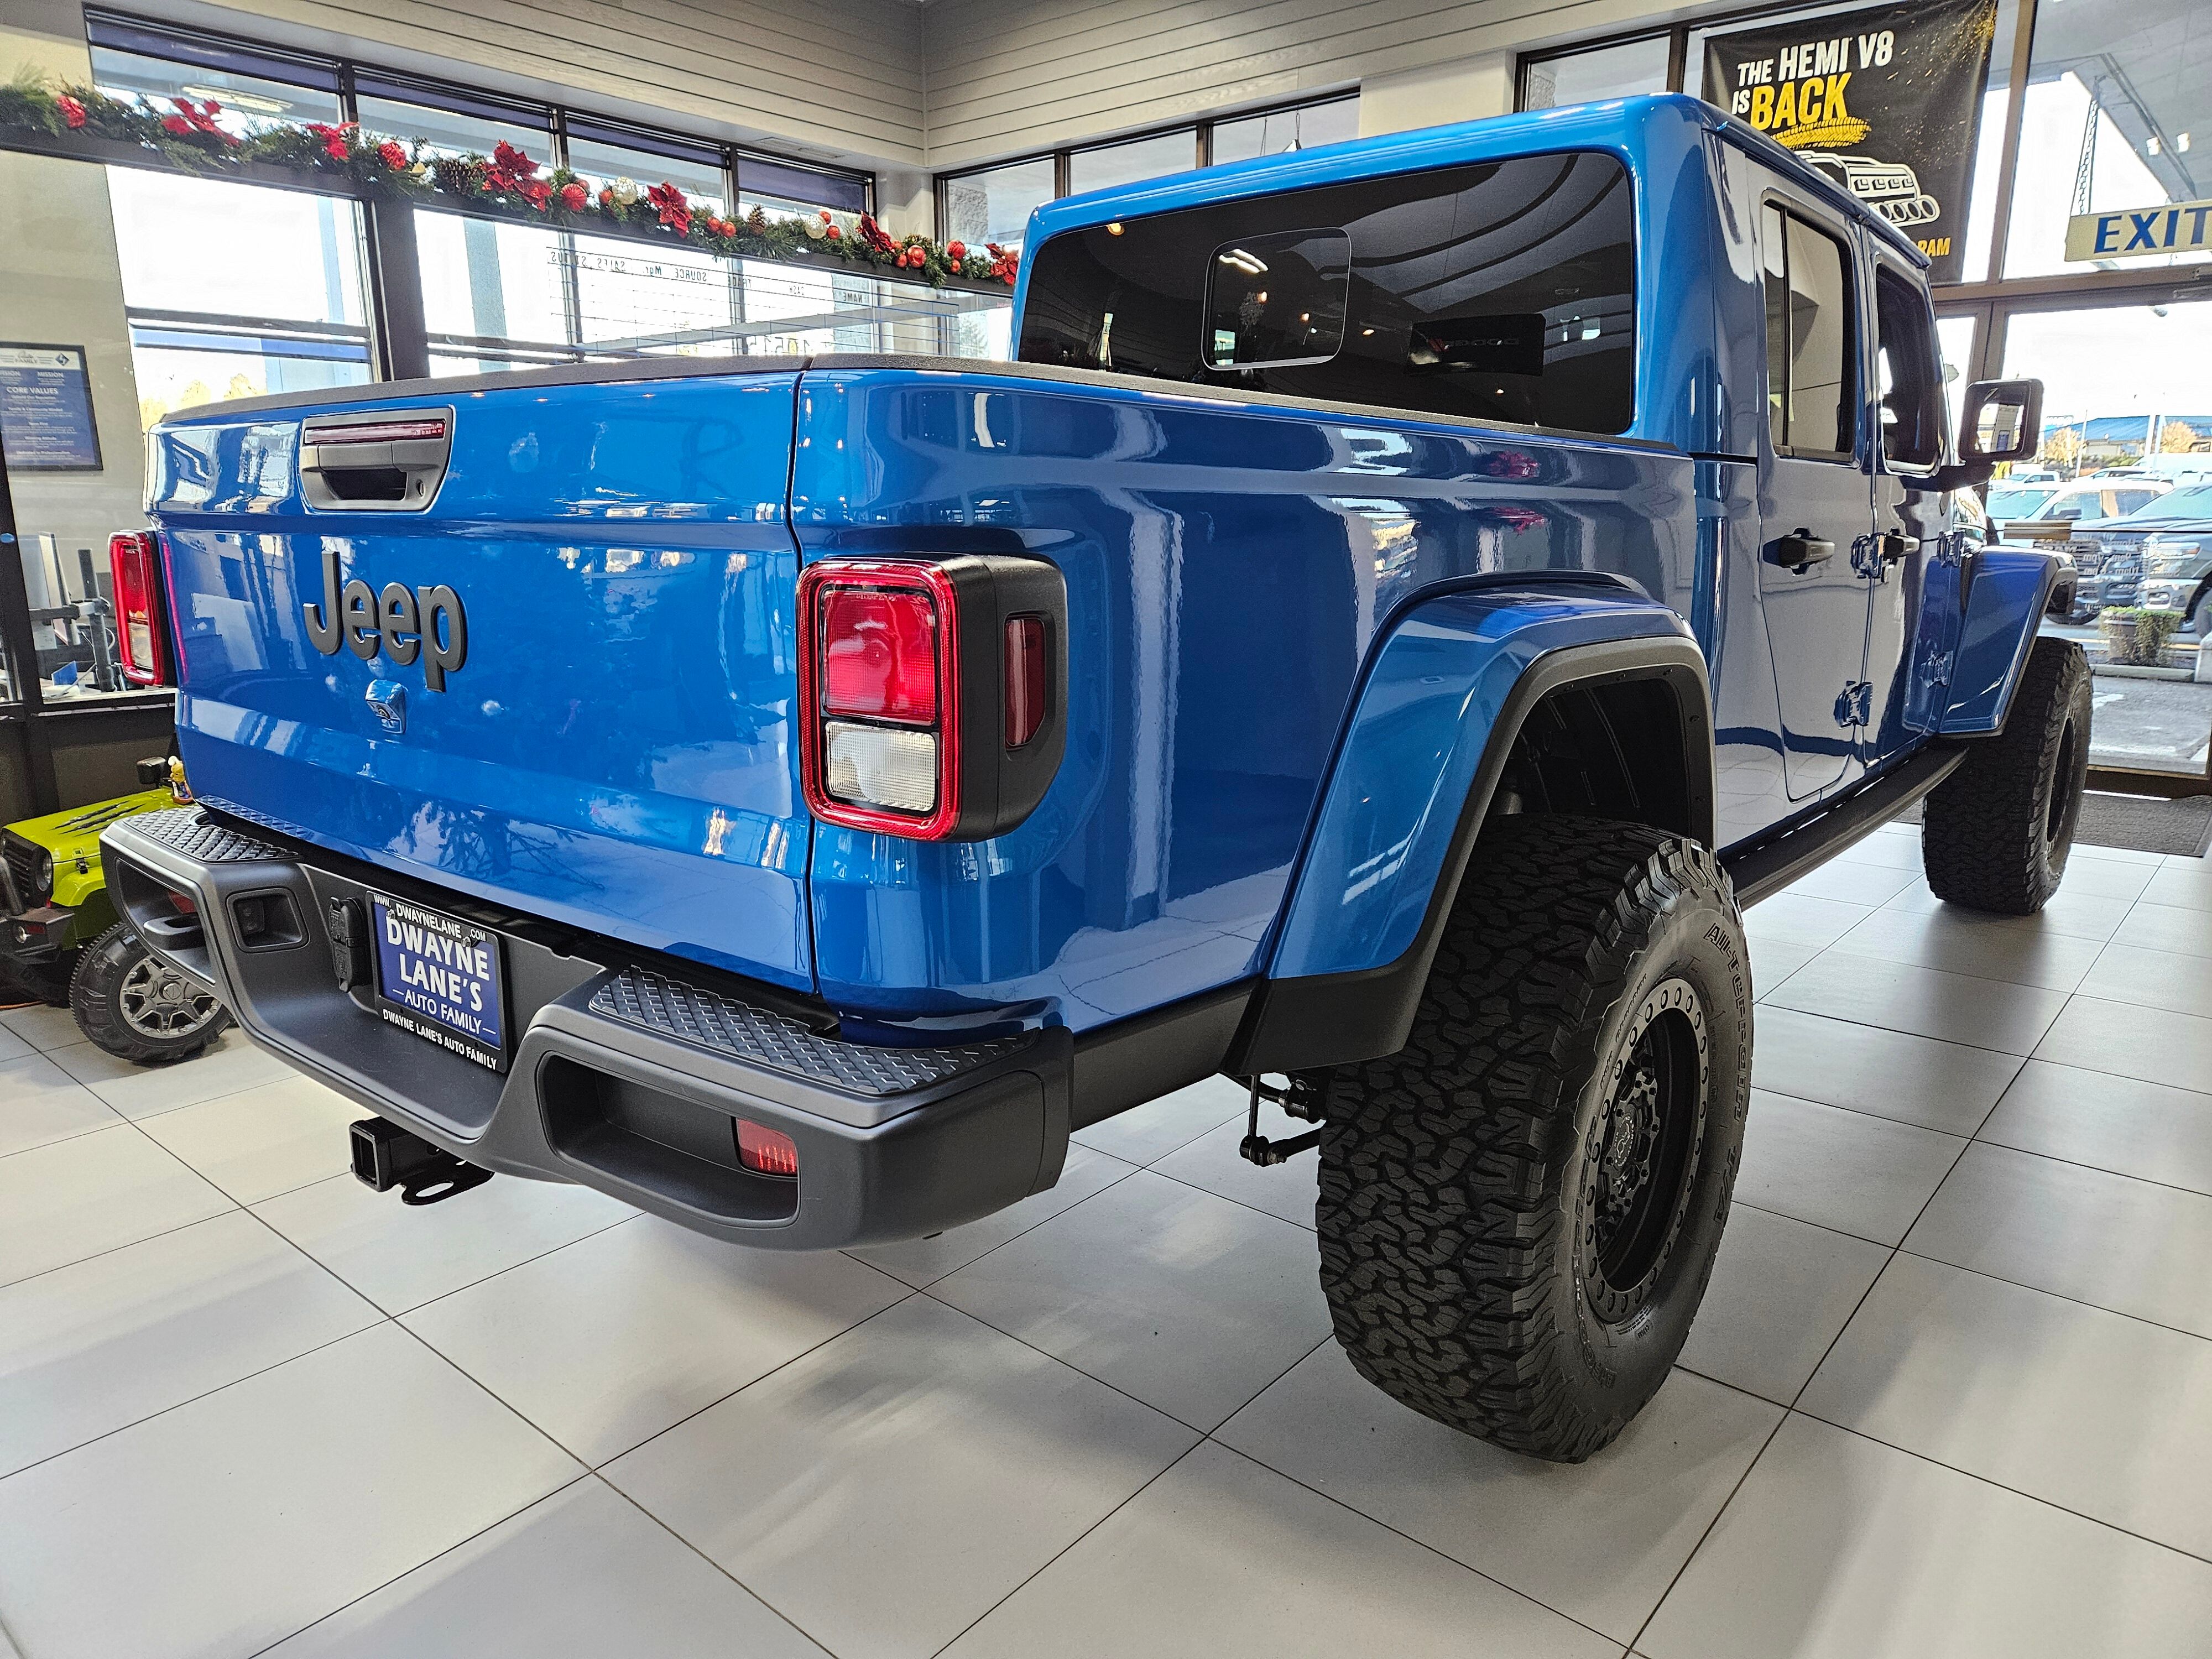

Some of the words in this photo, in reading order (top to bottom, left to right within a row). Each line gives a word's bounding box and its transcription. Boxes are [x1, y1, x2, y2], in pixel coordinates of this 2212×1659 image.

[1738, 58, 1773, 87] THE
[1778, 37, 1849, 82] HEMI
[1858, 30, 1895, 70] V8
[1731, 89, 1751, 114] IS
[1750, 72, 1852, 131] BACK
[2094, 206, 2212, 254] EXIT
[302, 550, 468, 692] Jeep
[385, 916, 490, 982] DWAYNE
[395, 902, 462, 939] DWAYNELANE
[399, 953, 482, 1012] LANE'S
[404, 989, 437, 1015] AUTO
[441, 1003, 482, 1035] FAMILY
[383, 1008, 415, 1032] DWAYNE
[416, 1022, 443, 1045] LANE'S
[444, 1036, 465, 1055] AUTO
[466, 1046, 497, 1071] FAMILY
